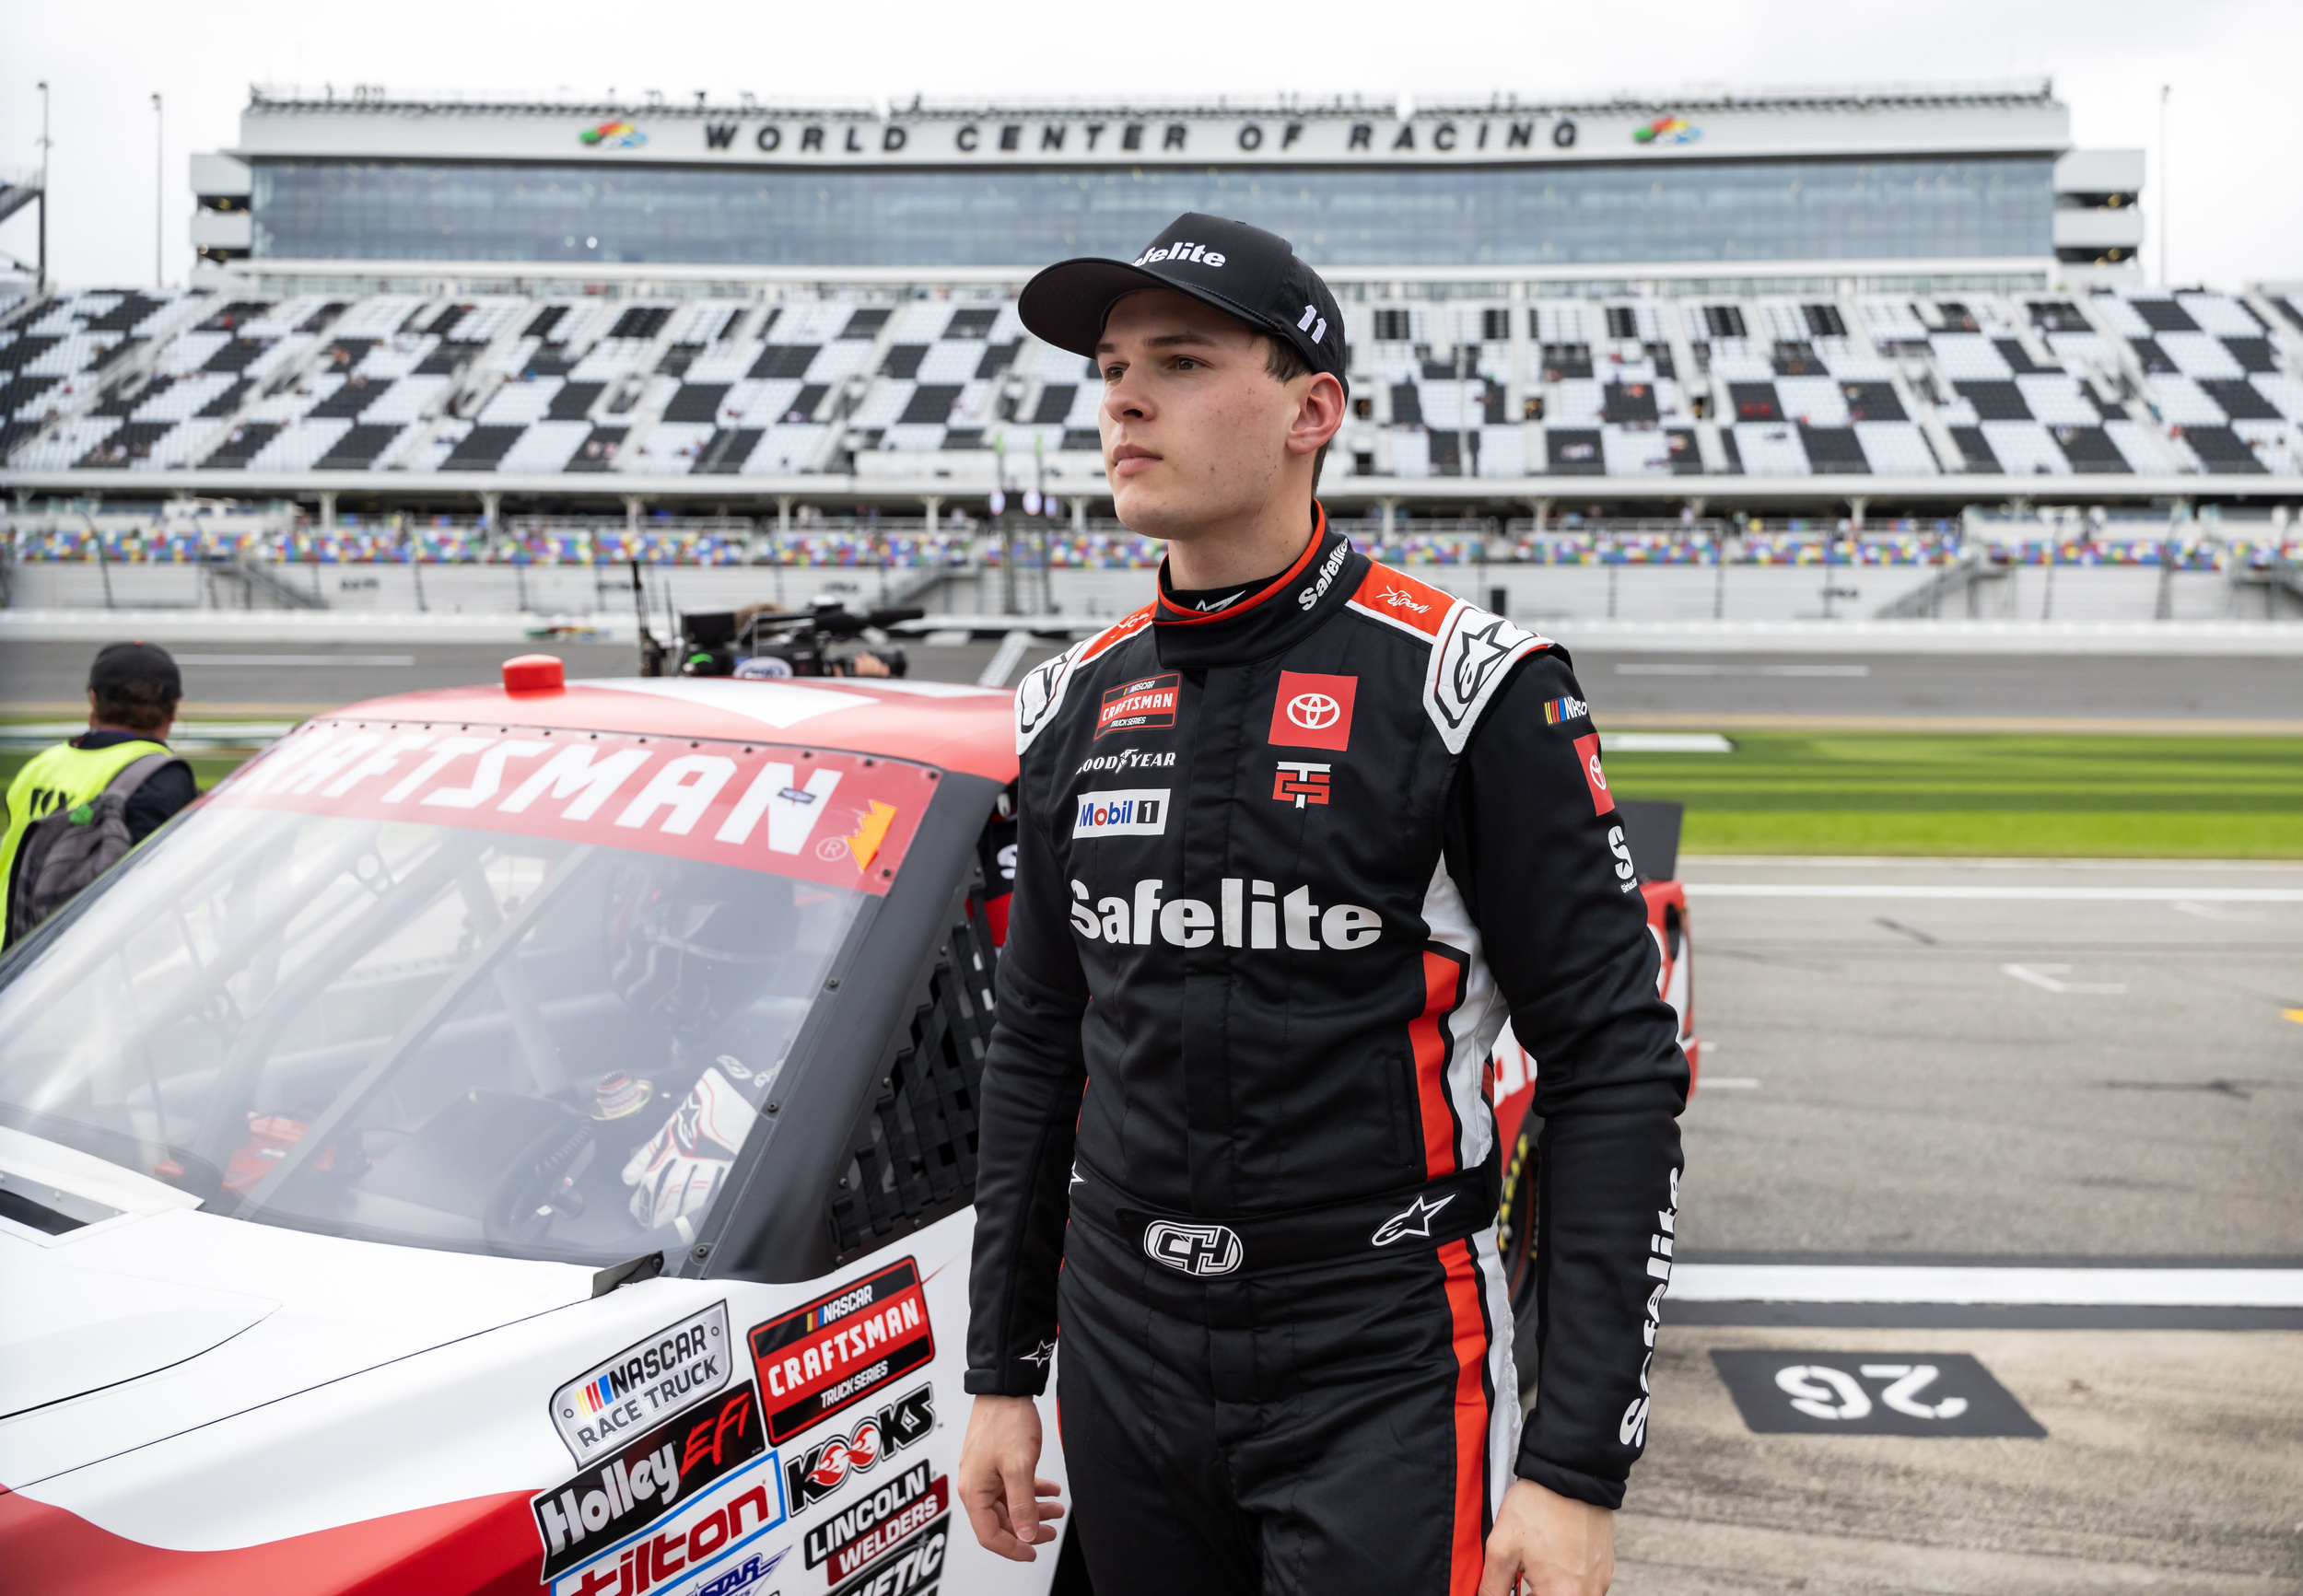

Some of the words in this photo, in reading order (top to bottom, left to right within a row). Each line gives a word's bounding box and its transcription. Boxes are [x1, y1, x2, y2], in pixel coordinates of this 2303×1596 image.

[706, 124, 907, 151] WORLD
[955, 123, 1187, 151] CENTER
[1238, 122, 1303, 150] OF
[1349, 121, 1578, 150] RACING
[1297, 304, 1327, 344] 11
[1298, 538, 1348, 611] Safelite
[1102, 693, 1173, 722] CRAFTSMAN
[1129, 681, 1155, 693] NASCAR
[1110, 718, 1128, 728] TRUCK
[1128, 716, 1147, 726] SERIES
[1079, 800, 1133, 827] Mobil
[1070, 879, 1383, 949] Safelite
[823, 1286, 873, 1323] NASCAR
[609, 1324, 707, 1400] NASCAR
[768, 1298, 919, 1397] CRAFTSMAN
[577, 1399, 643, 1448] RACE
[644, 1354, 719, 1409] TRUCK
[821, 1378, 853, 1408] TRUCK
[853, 1360, 889, 1389] SERIES
[1774, 1365, 1969, 1420] 26
[541, 1442, 680, 1556] Holley
[679, 1392, 750, 1479] EFI
[786, 1383, 936, 1516] KOOKS
[810, 1465, 927, 1562] LINCOLN
[839, 1494, 938, 1574] WELDERS
